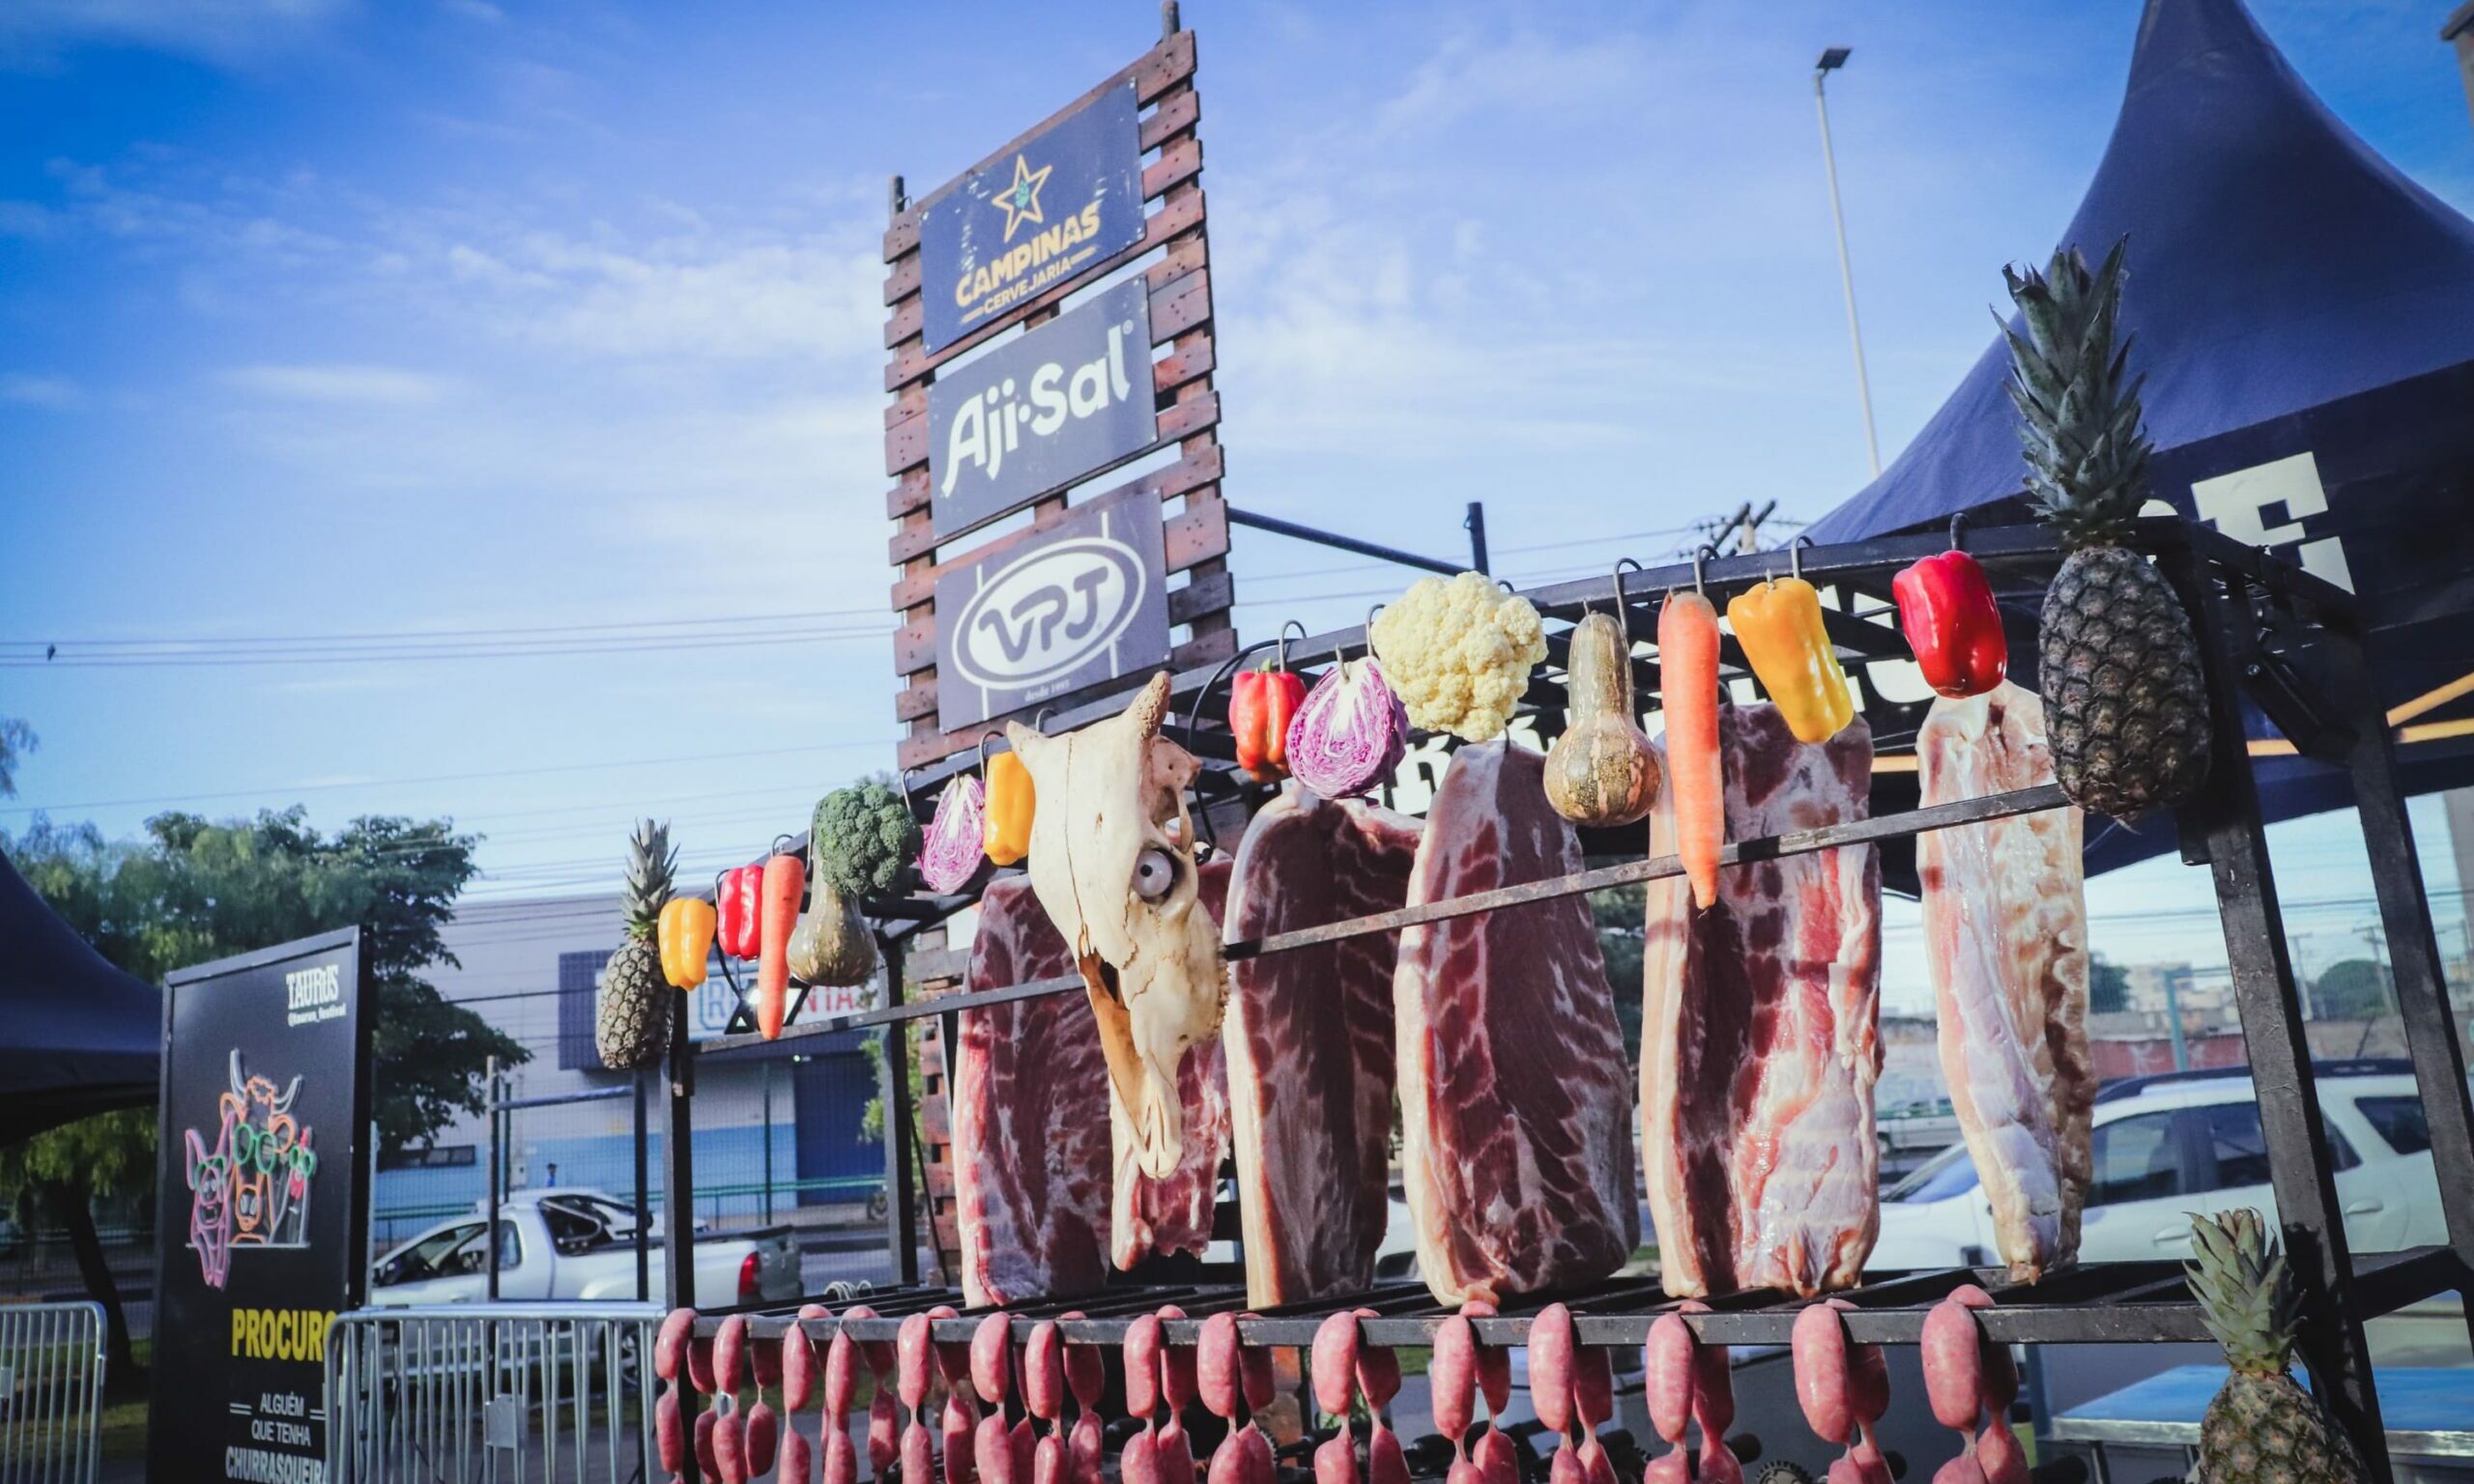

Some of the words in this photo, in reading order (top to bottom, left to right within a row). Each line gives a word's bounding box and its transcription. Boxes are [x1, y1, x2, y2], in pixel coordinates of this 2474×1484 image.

[955, 199, 1105, 308] CAMPINAS
[984, 256, 1073, 314] CERVEJARIA
[978, 565, 1109, 664] VPJ
[286, 964, 339, 1011] TAURUS
[259, 1390, 304, 1417] ALGUÉM
[251, 1418, 274, 1441] QUE
[275, 1421, 311, 1446] TENHA
